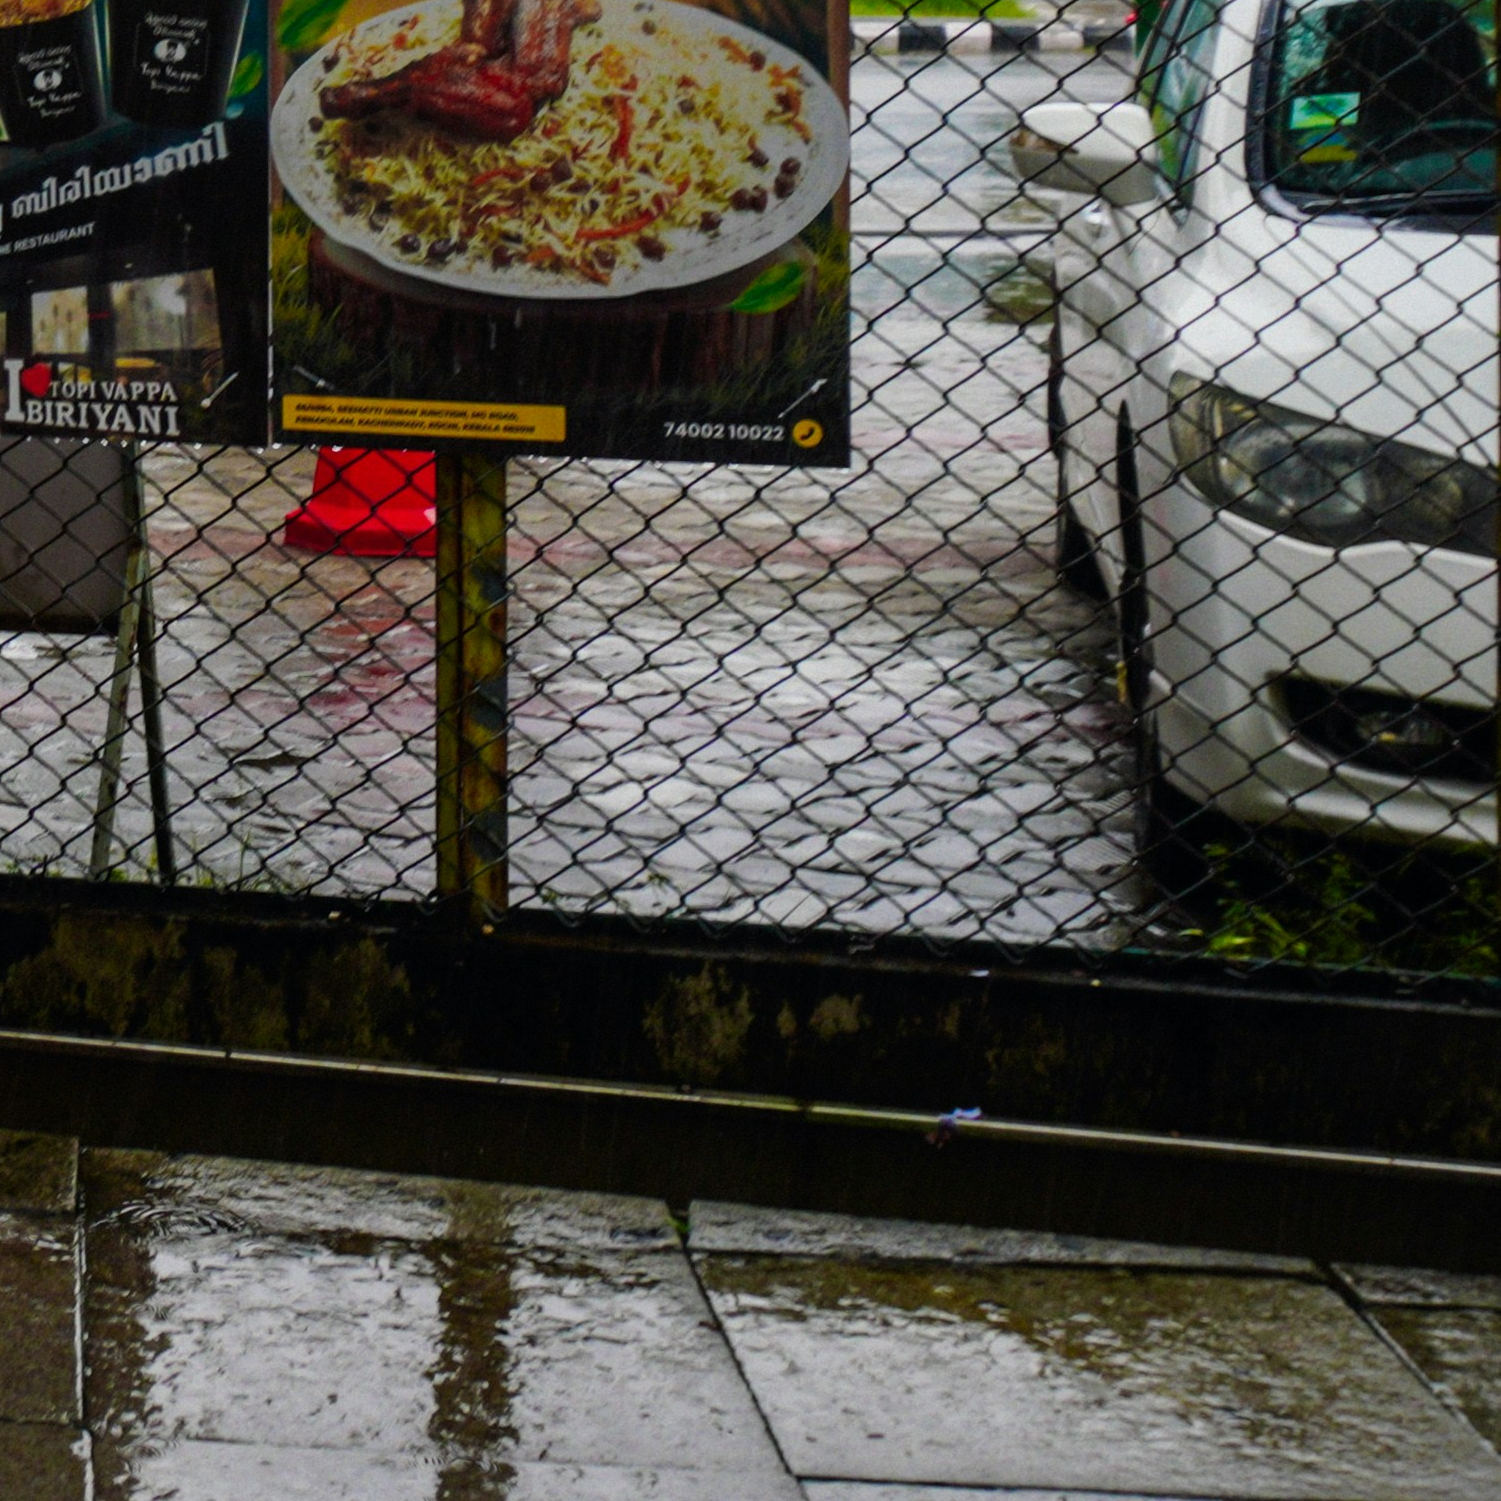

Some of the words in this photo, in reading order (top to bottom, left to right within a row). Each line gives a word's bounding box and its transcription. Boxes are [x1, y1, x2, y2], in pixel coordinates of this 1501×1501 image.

[13, 221, 96, 254] RESTAURANT
[4, 358, 26, 423] I
[50, 380, 97, 400] TOPI
[101, 380, 178, 402] VAPPA
[26, 400, 181, 437] BIRIYANI
